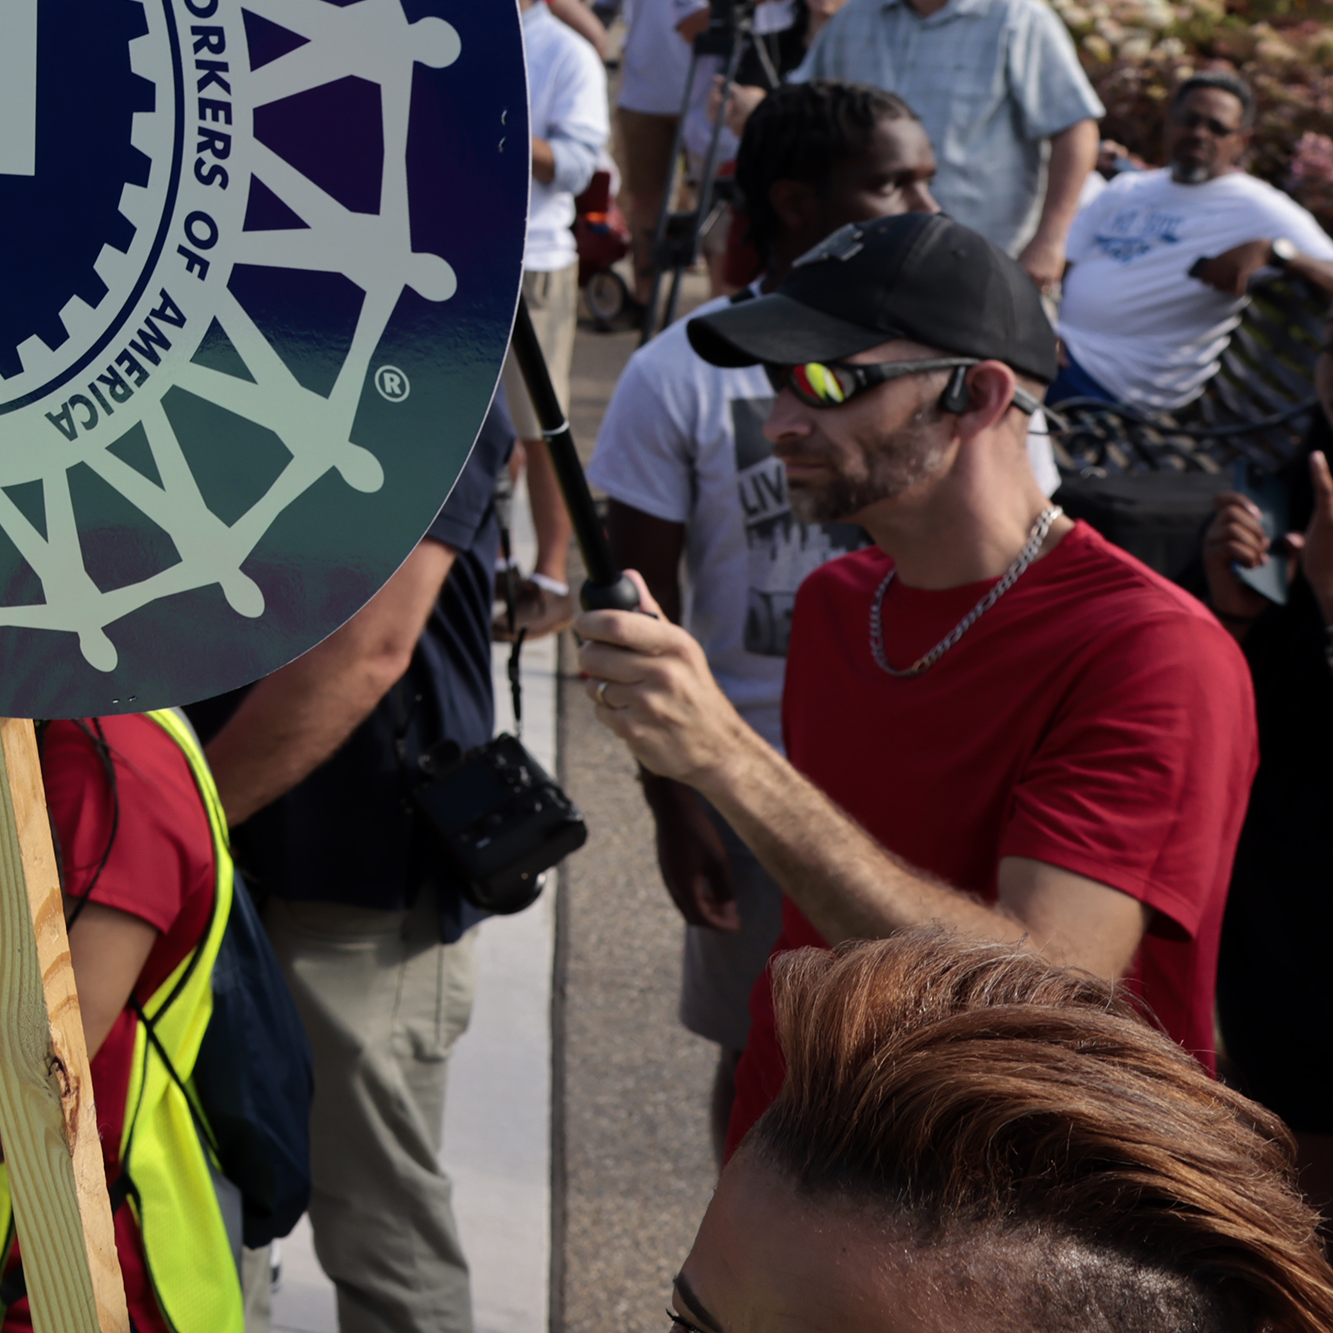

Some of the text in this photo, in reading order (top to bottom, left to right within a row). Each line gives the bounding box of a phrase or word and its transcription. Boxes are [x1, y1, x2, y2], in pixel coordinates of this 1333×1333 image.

[175, 209, 220, 282] OF
[44, 286, 187, 442] AMERICA
[736, 465, 786, 516] LIV
